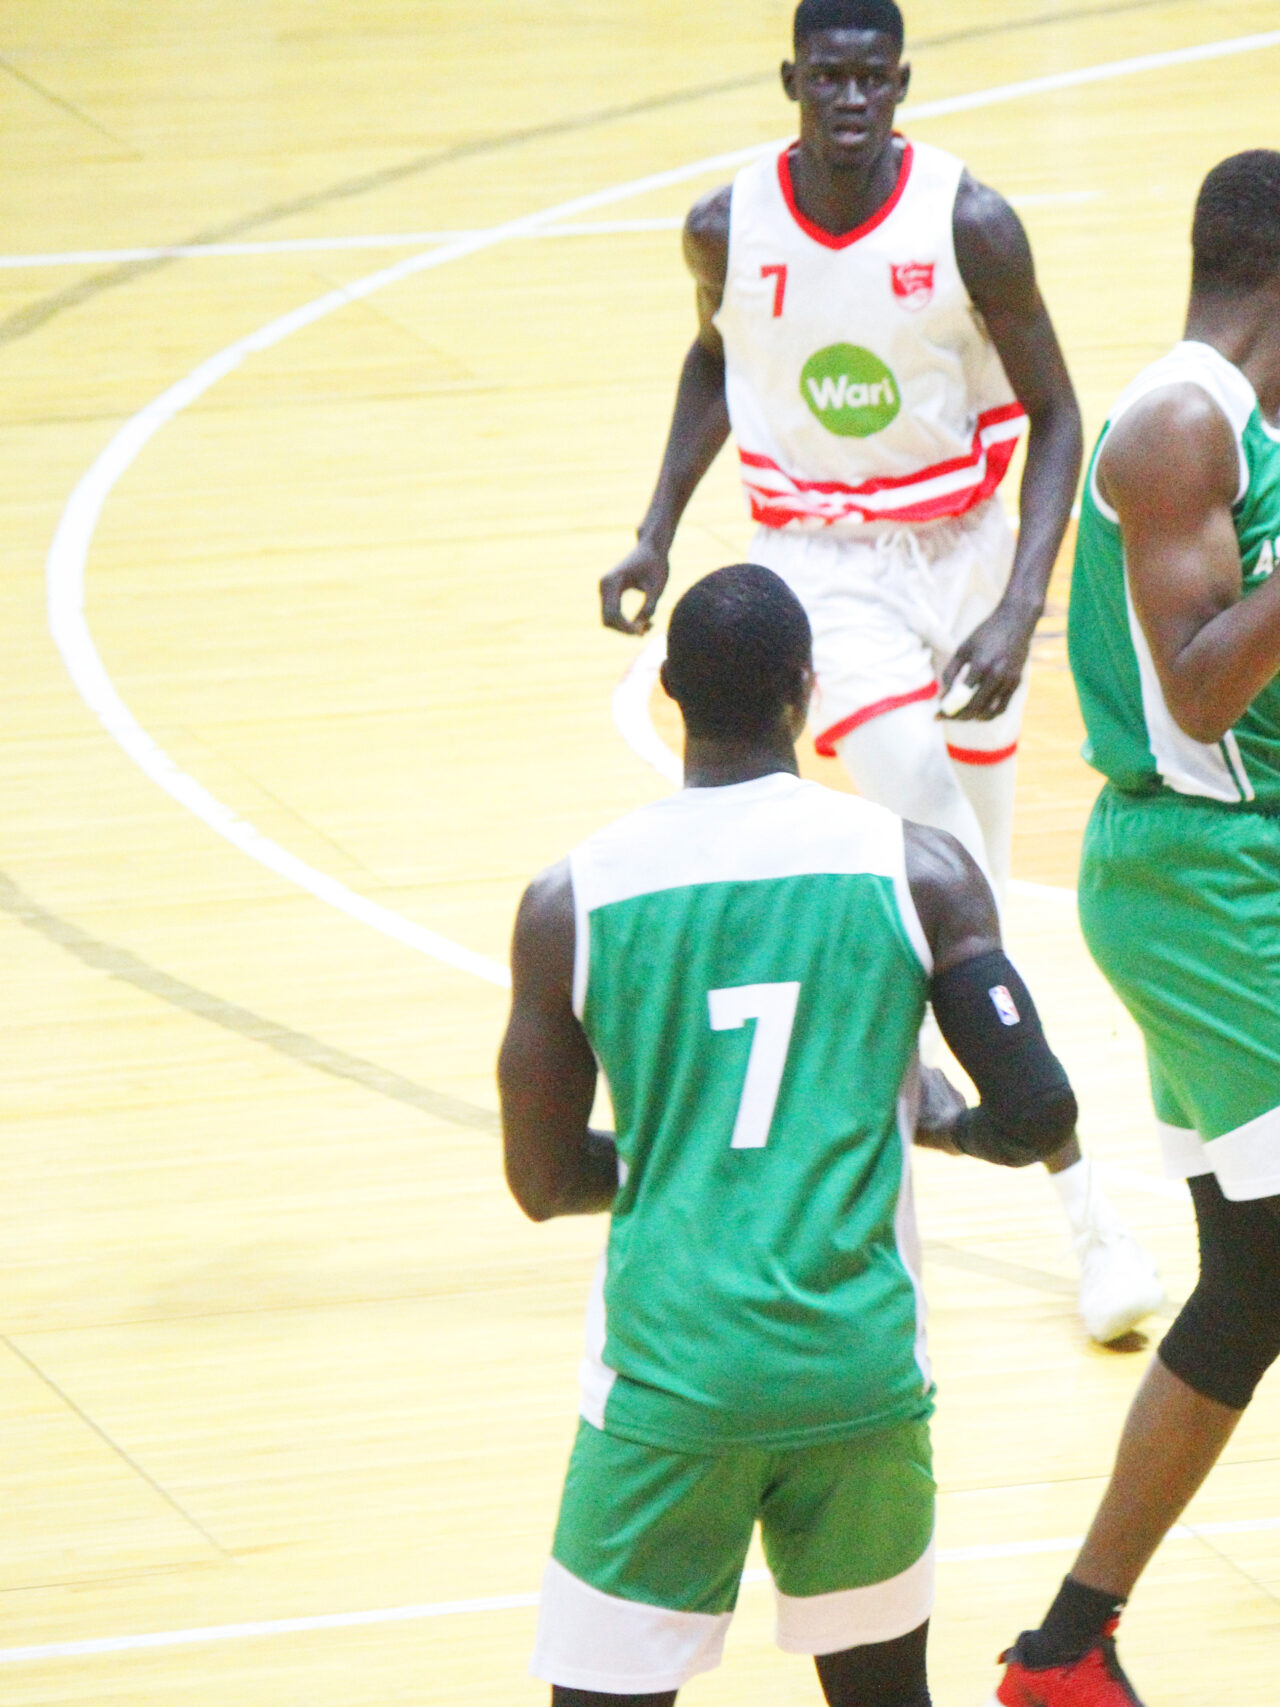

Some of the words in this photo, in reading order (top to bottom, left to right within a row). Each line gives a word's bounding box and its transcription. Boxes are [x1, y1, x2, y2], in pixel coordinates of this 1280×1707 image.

[760, 264, 788, 318] 7
[806, 374, 896, 412] Wari
[707, 981, 802, 1149] 7
